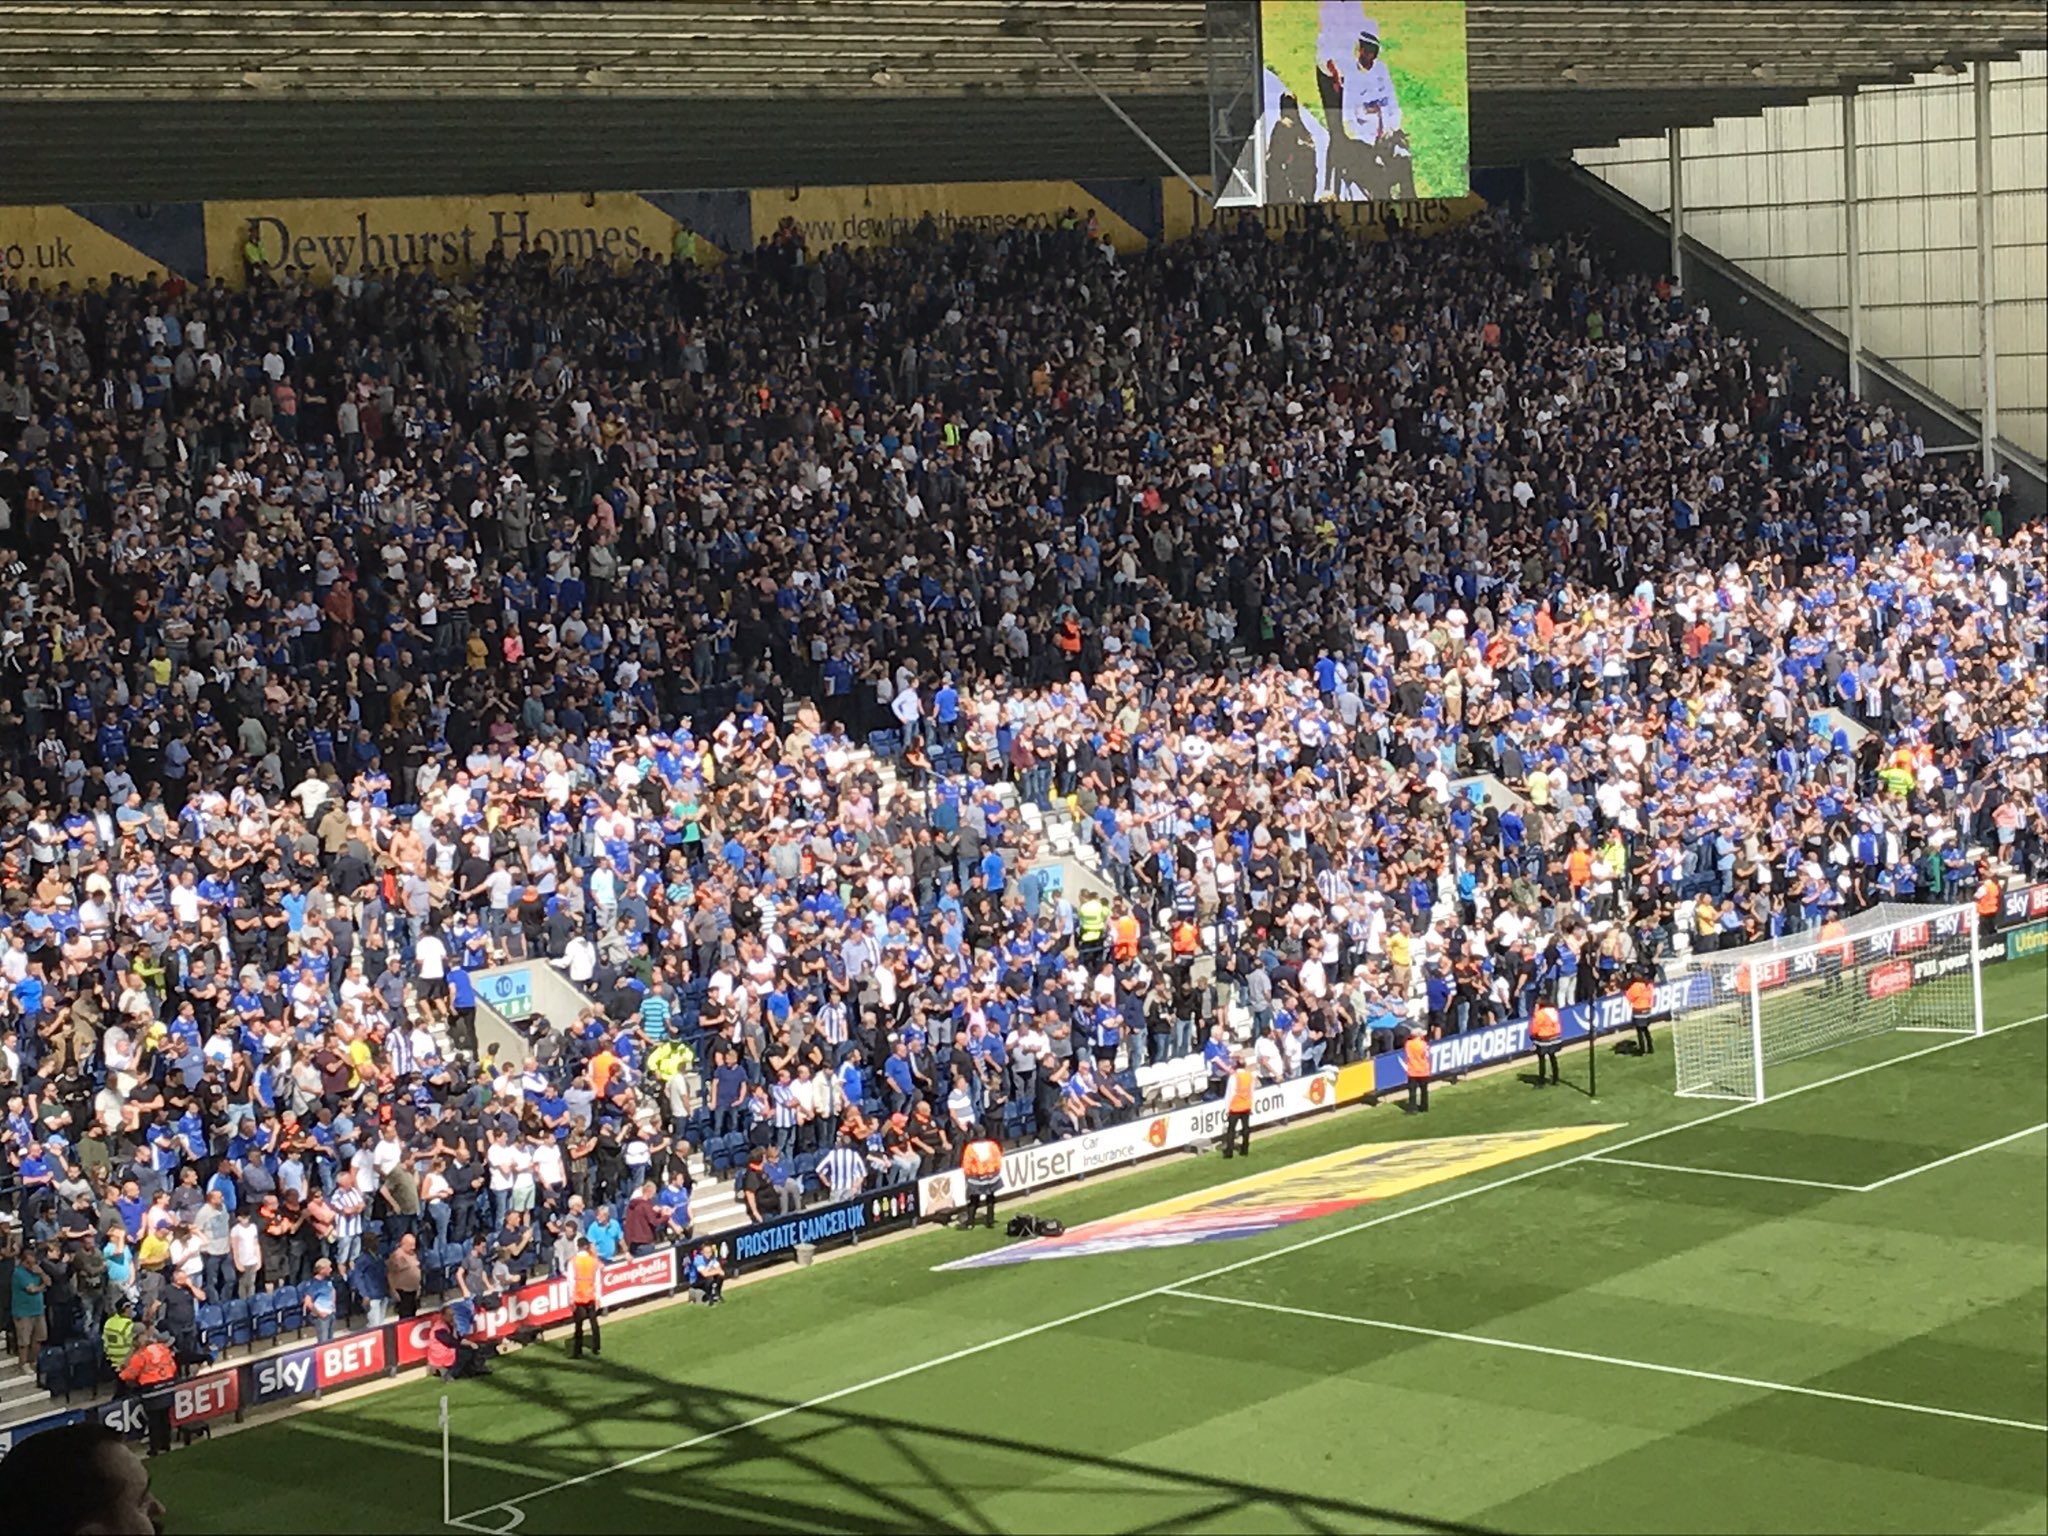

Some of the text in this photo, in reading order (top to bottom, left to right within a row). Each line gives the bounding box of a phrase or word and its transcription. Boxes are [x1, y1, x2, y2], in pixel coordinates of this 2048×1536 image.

[246, 211, 642, 270] Dewhurst Homes
[2006, 892, 2029, 917] sky
[1870, 931, 1894, 954] sky
[1899, 923, 1924, 945] BET
[1721, 966, 1738, 992] sk
[1914, 958, 1937, 979] Fill
[1601, 979, 1692, 1028] TEMOBET
[1430, 1022, 1528, 1073] TEMPOBET
[1191, 1093, 1284, 1133] ajgro.com
[1082, 1136, 1099, 1151] Car
[1083, 1143, 1135, 1168] Insurance
[1005, 1148, 1076, 1188] Wiser
[736, 1203, 866, 1261] PROSTATE CANCER UK
[603, 1257, 668, 1287] Campbells
[409, 1281, 572, 1350] Cpbell
[258, 1337, 377, 1395] sky BET
[174, 1377, 230, 1420] BET
